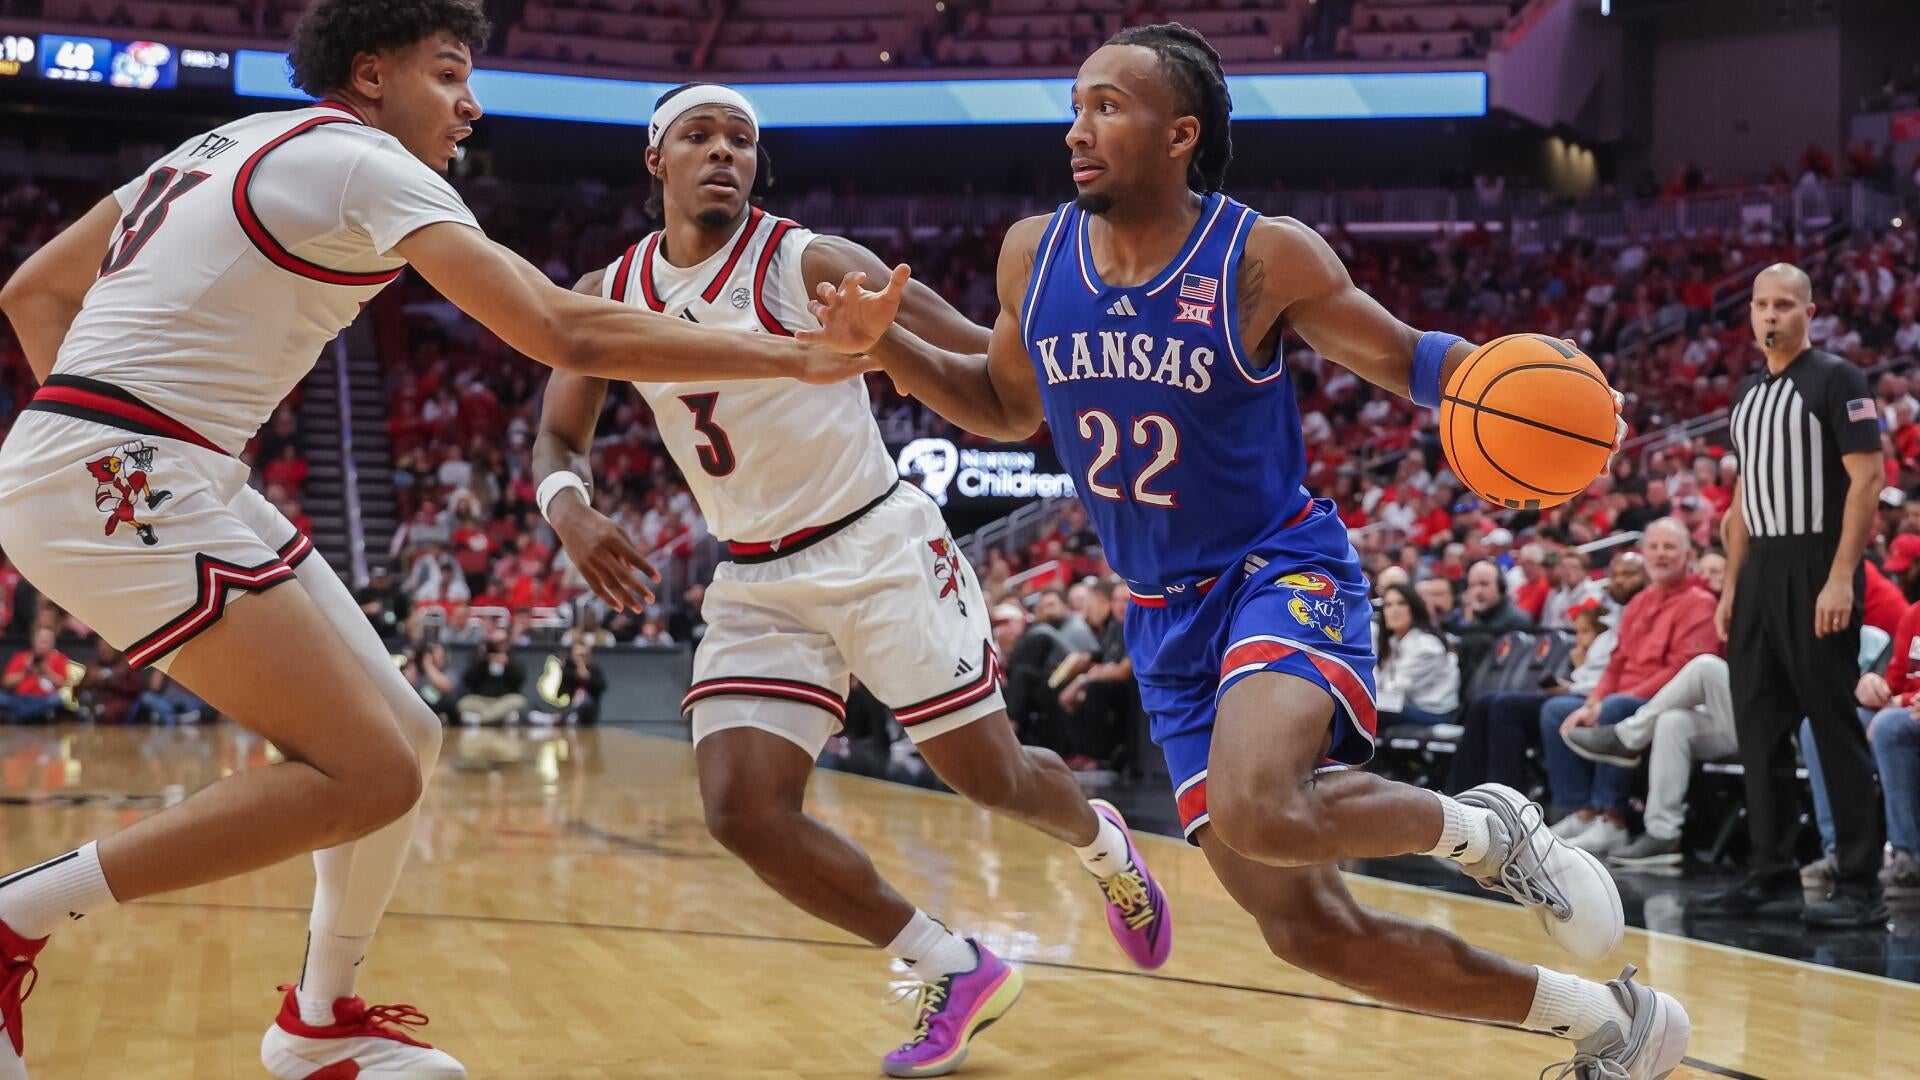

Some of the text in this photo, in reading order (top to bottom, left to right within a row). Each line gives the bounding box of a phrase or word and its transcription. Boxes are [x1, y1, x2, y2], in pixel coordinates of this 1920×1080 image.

[1175, 299, 1215, 327] XII
[1036, 331, 1214, 394] KANSAS
[677, 391, 736, 477] 3
[1078, 408, 1180, 508] 22
[1314, 600, 1334, 617] KU
